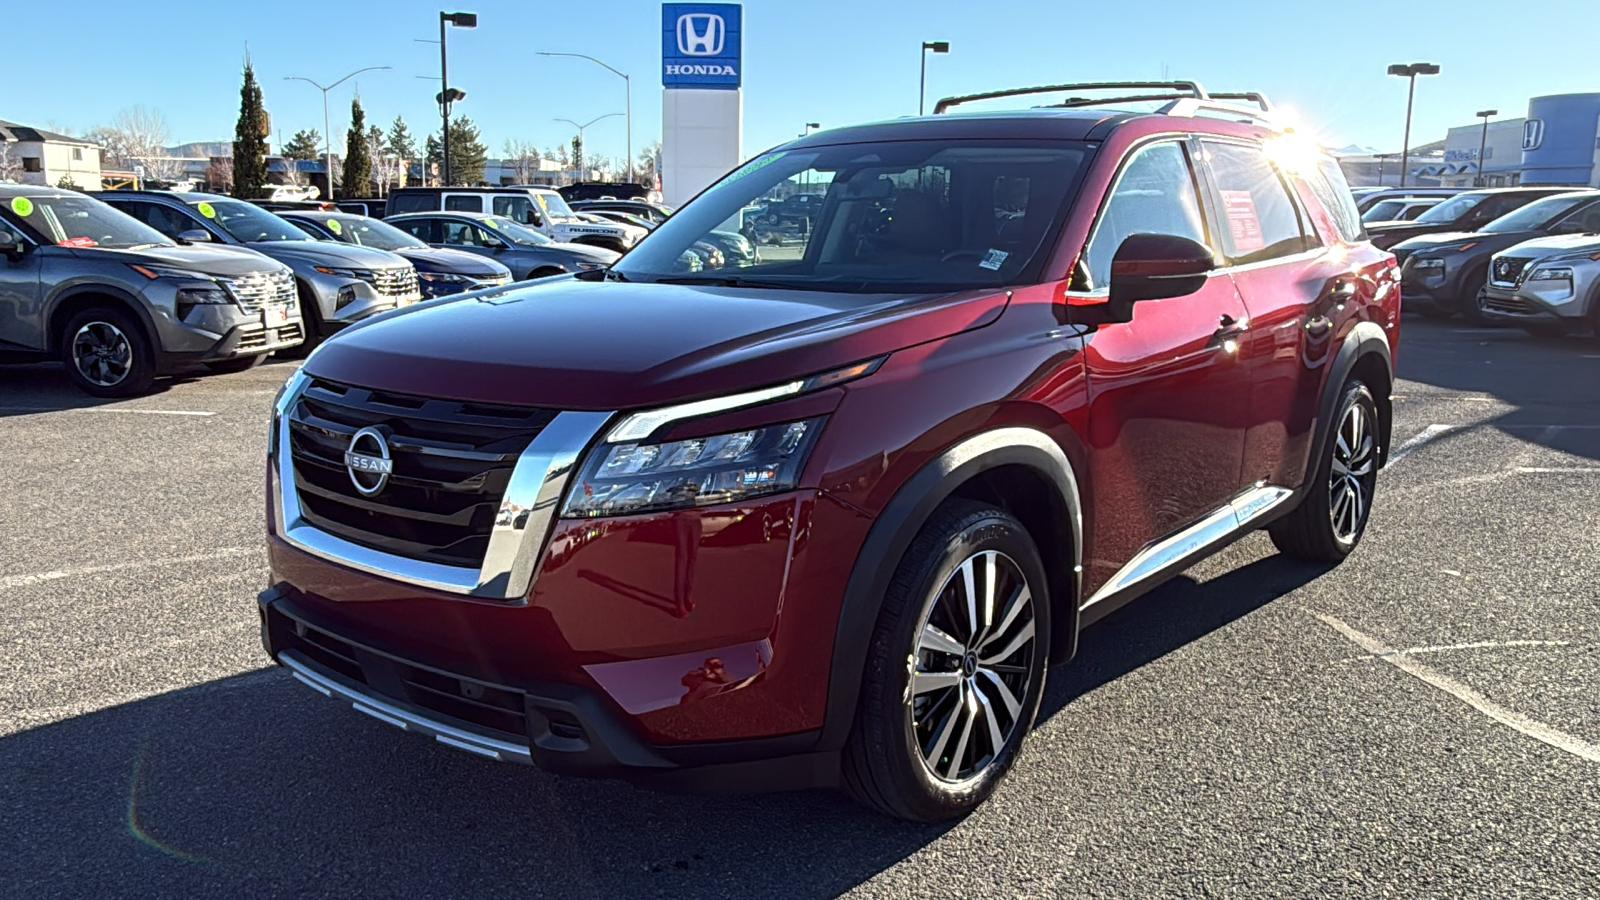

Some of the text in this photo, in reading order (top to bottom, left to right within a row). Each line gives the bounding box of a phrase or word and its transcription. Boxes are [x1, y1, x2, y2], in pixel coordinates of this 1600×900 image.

[665, 65, 737, 76] HONDA
[569, 227, 618, 235] RUBICON
[346, 453, 390, 471] NISSAN
